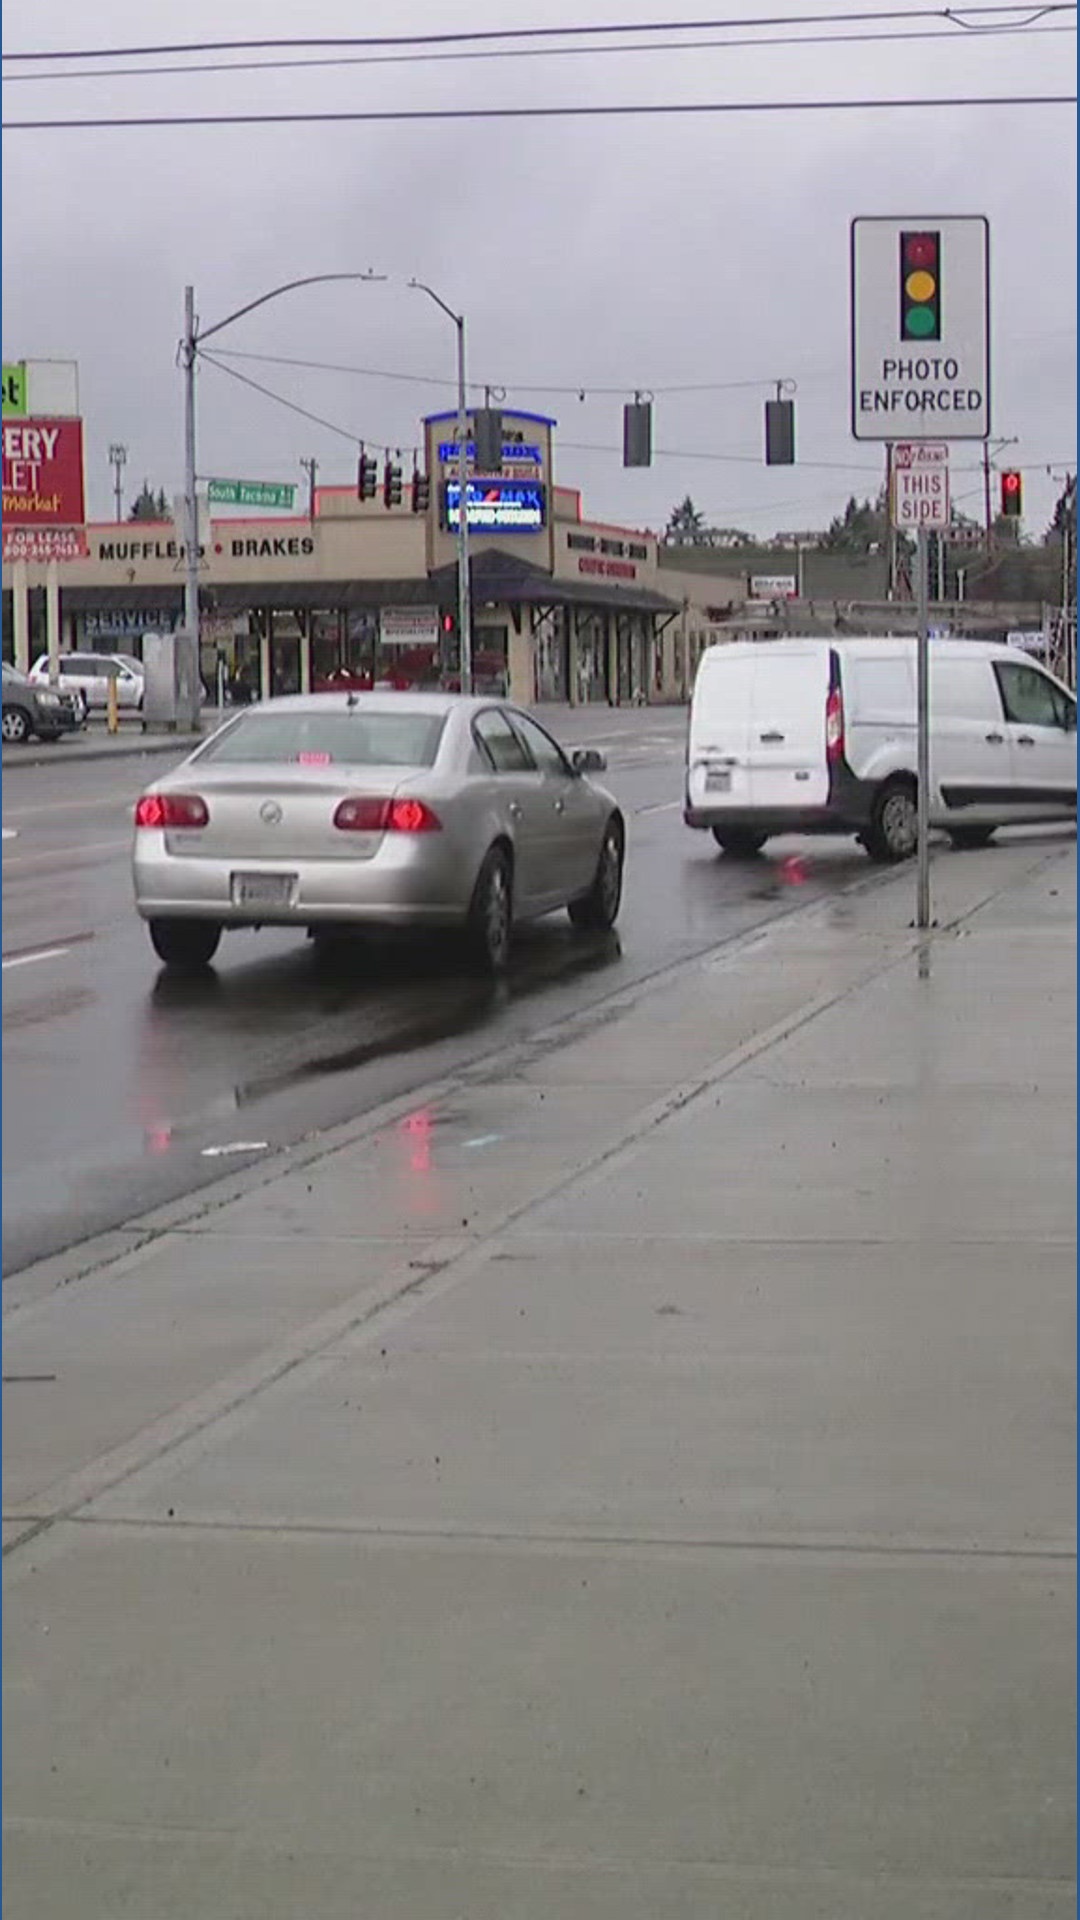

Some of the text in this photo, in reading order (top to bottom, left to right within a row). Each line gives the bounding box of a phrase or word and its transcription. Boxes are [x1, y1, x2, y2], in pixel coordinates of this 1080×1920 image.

[883, 358, 959, 381] PHOTO
[2, 375, 20, 406] t
[859, 390, 982, 412] ENFORCED
[2, 427, 59, 460] ERY
[209, 485, 235, 500] South
[240, 486, 277, 503] Tacoma
[903, 475, 941, 495] THIS
[449, 491, 483, 508] PO
[902, 500, 941, 519] SIDE
[7, 531, 75, 544] FOR LEASE
[99, 538, 314, 560] MUFFLE BRAKES
[86, 609, 171, 626] SERVICE
